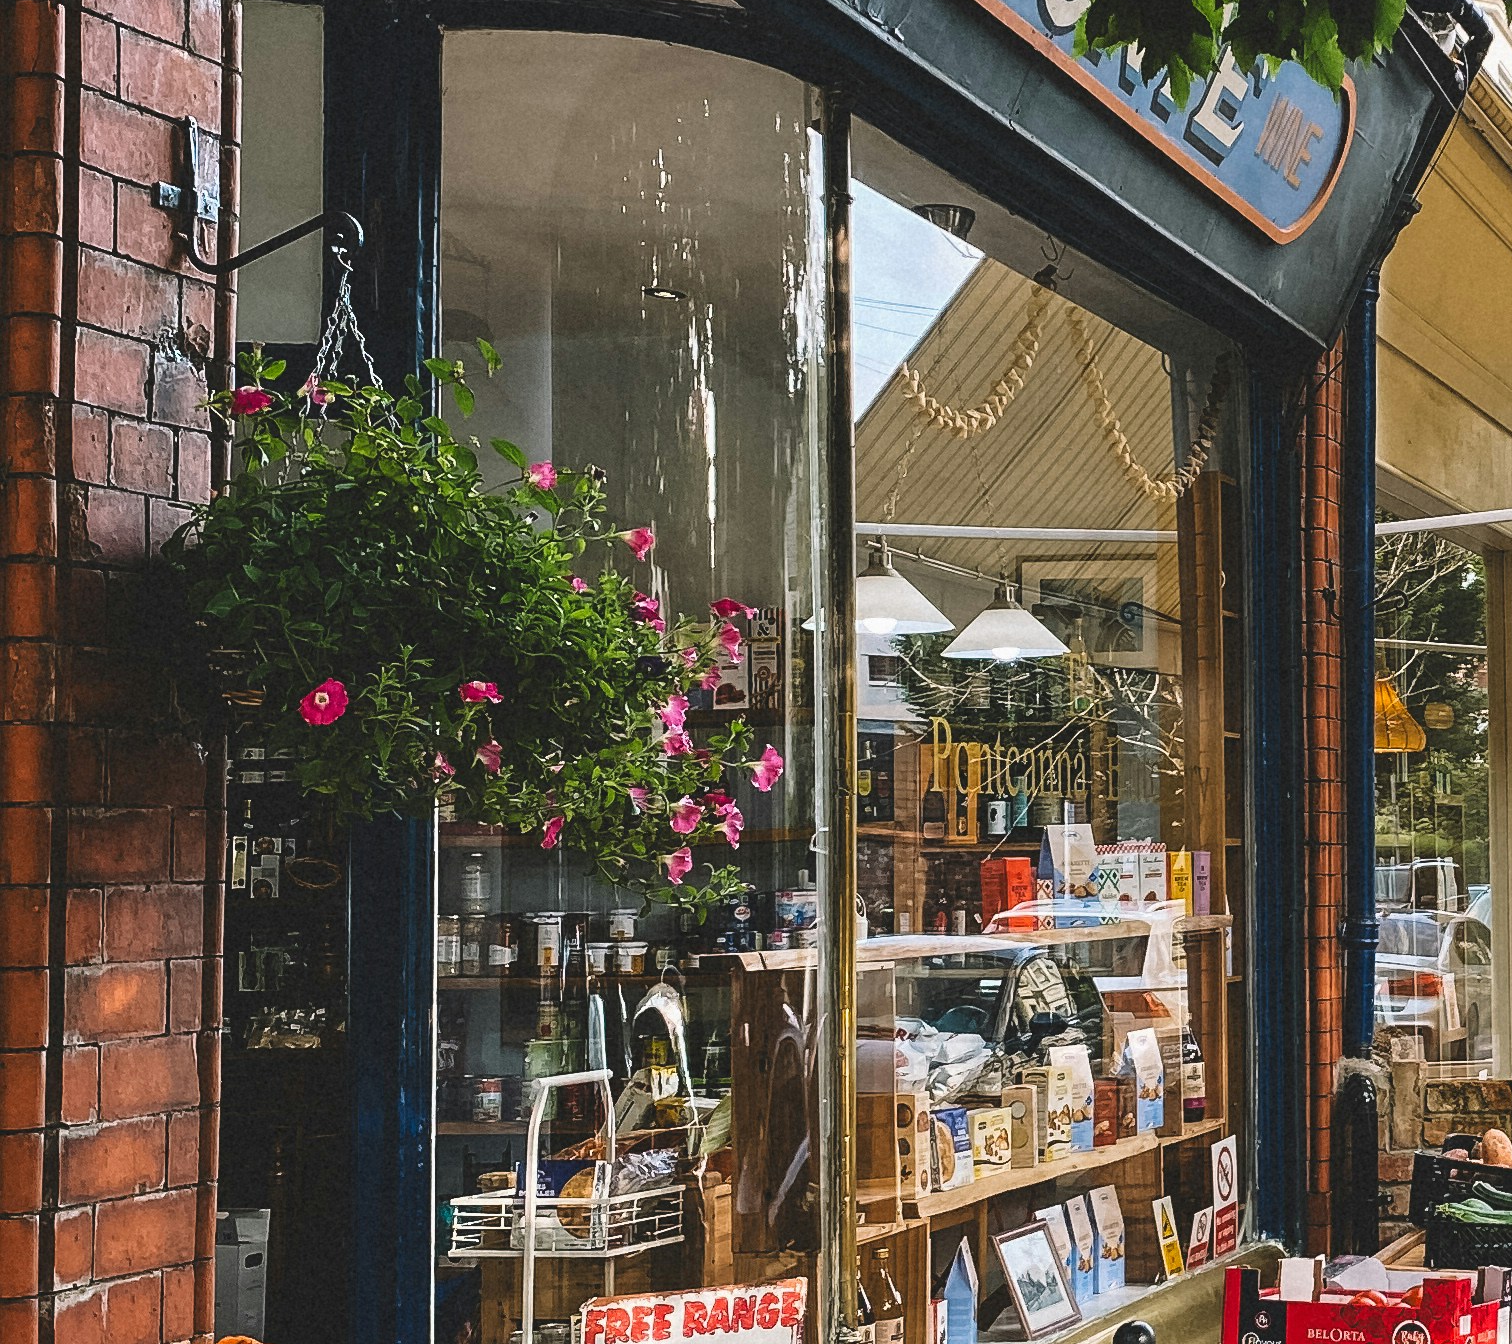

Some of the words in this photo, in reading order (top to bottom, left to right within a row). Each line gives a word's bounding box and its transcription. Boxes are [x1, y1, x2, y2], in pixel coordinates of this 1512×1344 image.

[1255, 92, 1323, 190] WINE
[682, 1291, 802, 1339] RANGE
[1307, 1327, 1366, 1342] BELORTA
